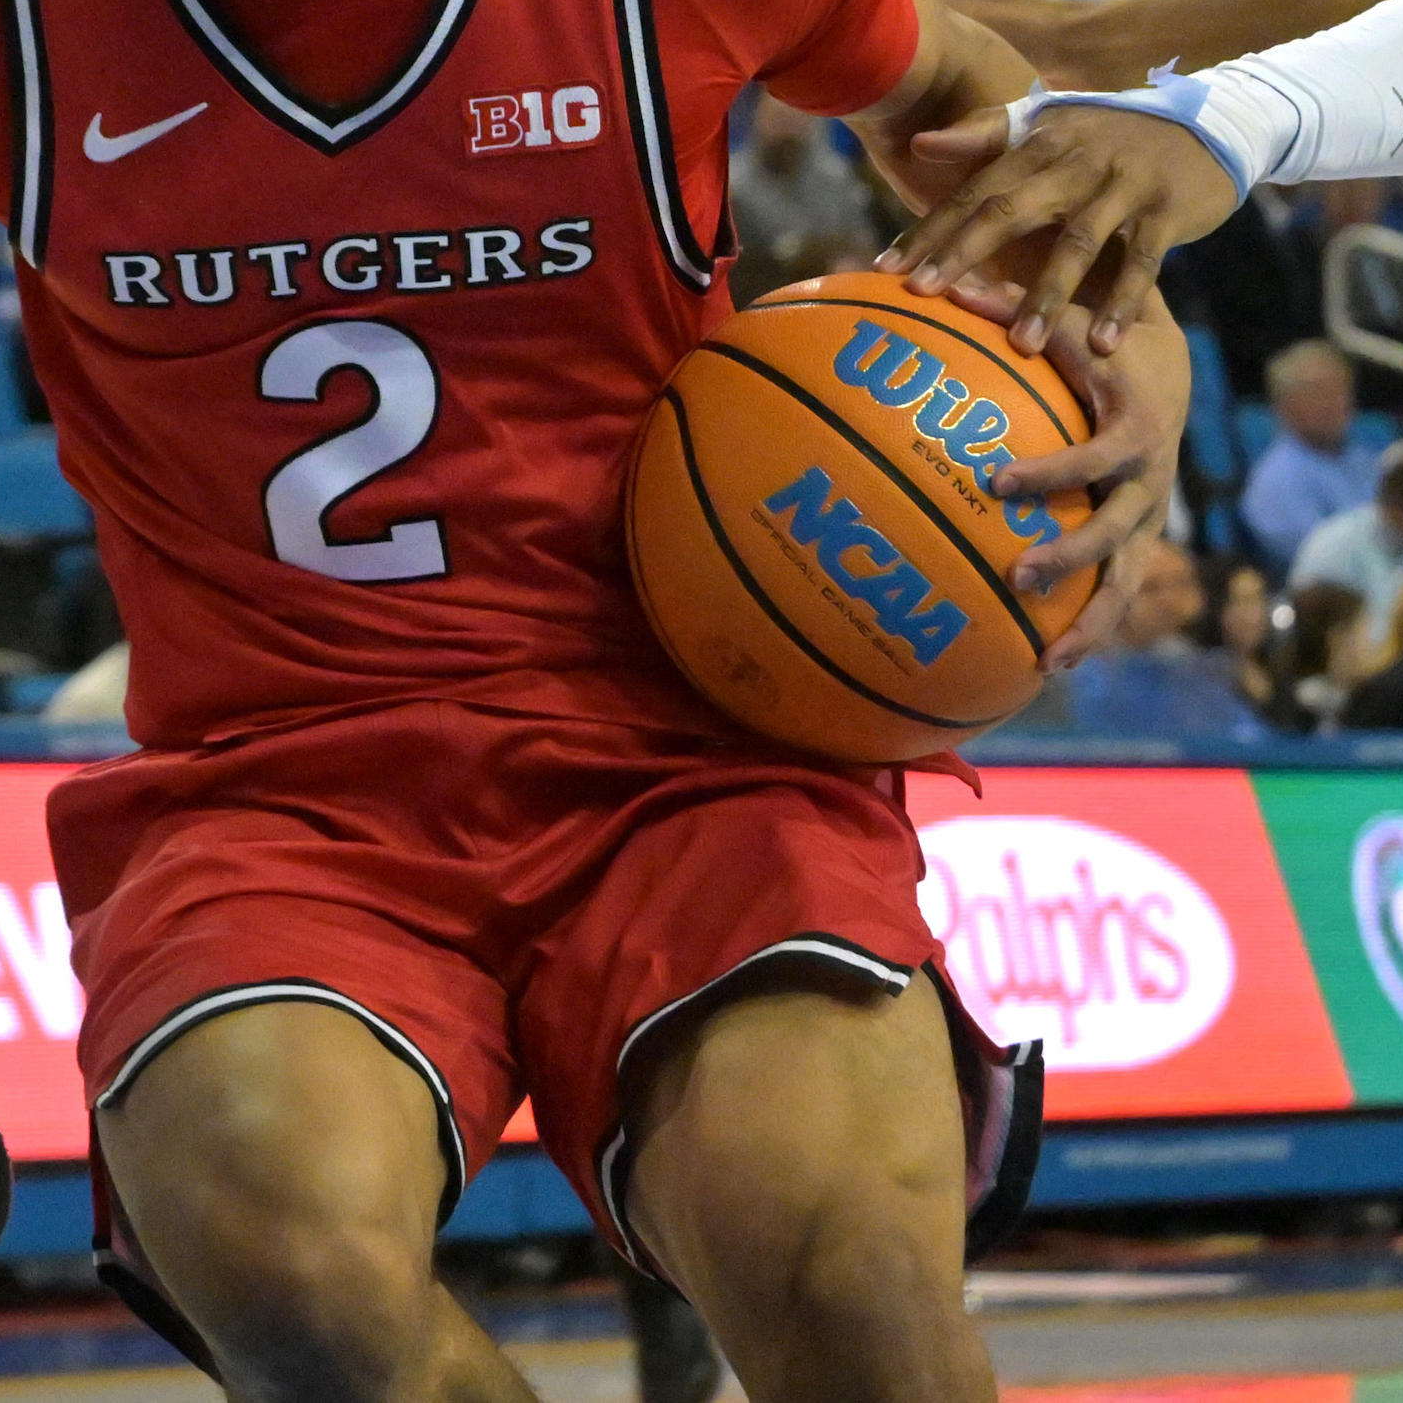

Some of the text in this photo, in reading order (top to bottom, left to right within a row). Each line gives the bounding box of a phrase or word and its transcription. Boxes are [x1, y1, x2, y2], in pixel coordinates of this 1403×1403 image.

[104, 218, 595, 305] RUTGERS
[258, 318, 448, 582] 2
[832, 318, 1064, 597] Wilso
[910, 439, 989, 518] EVO NXT
[763, 465, 971, 669] NCAA
